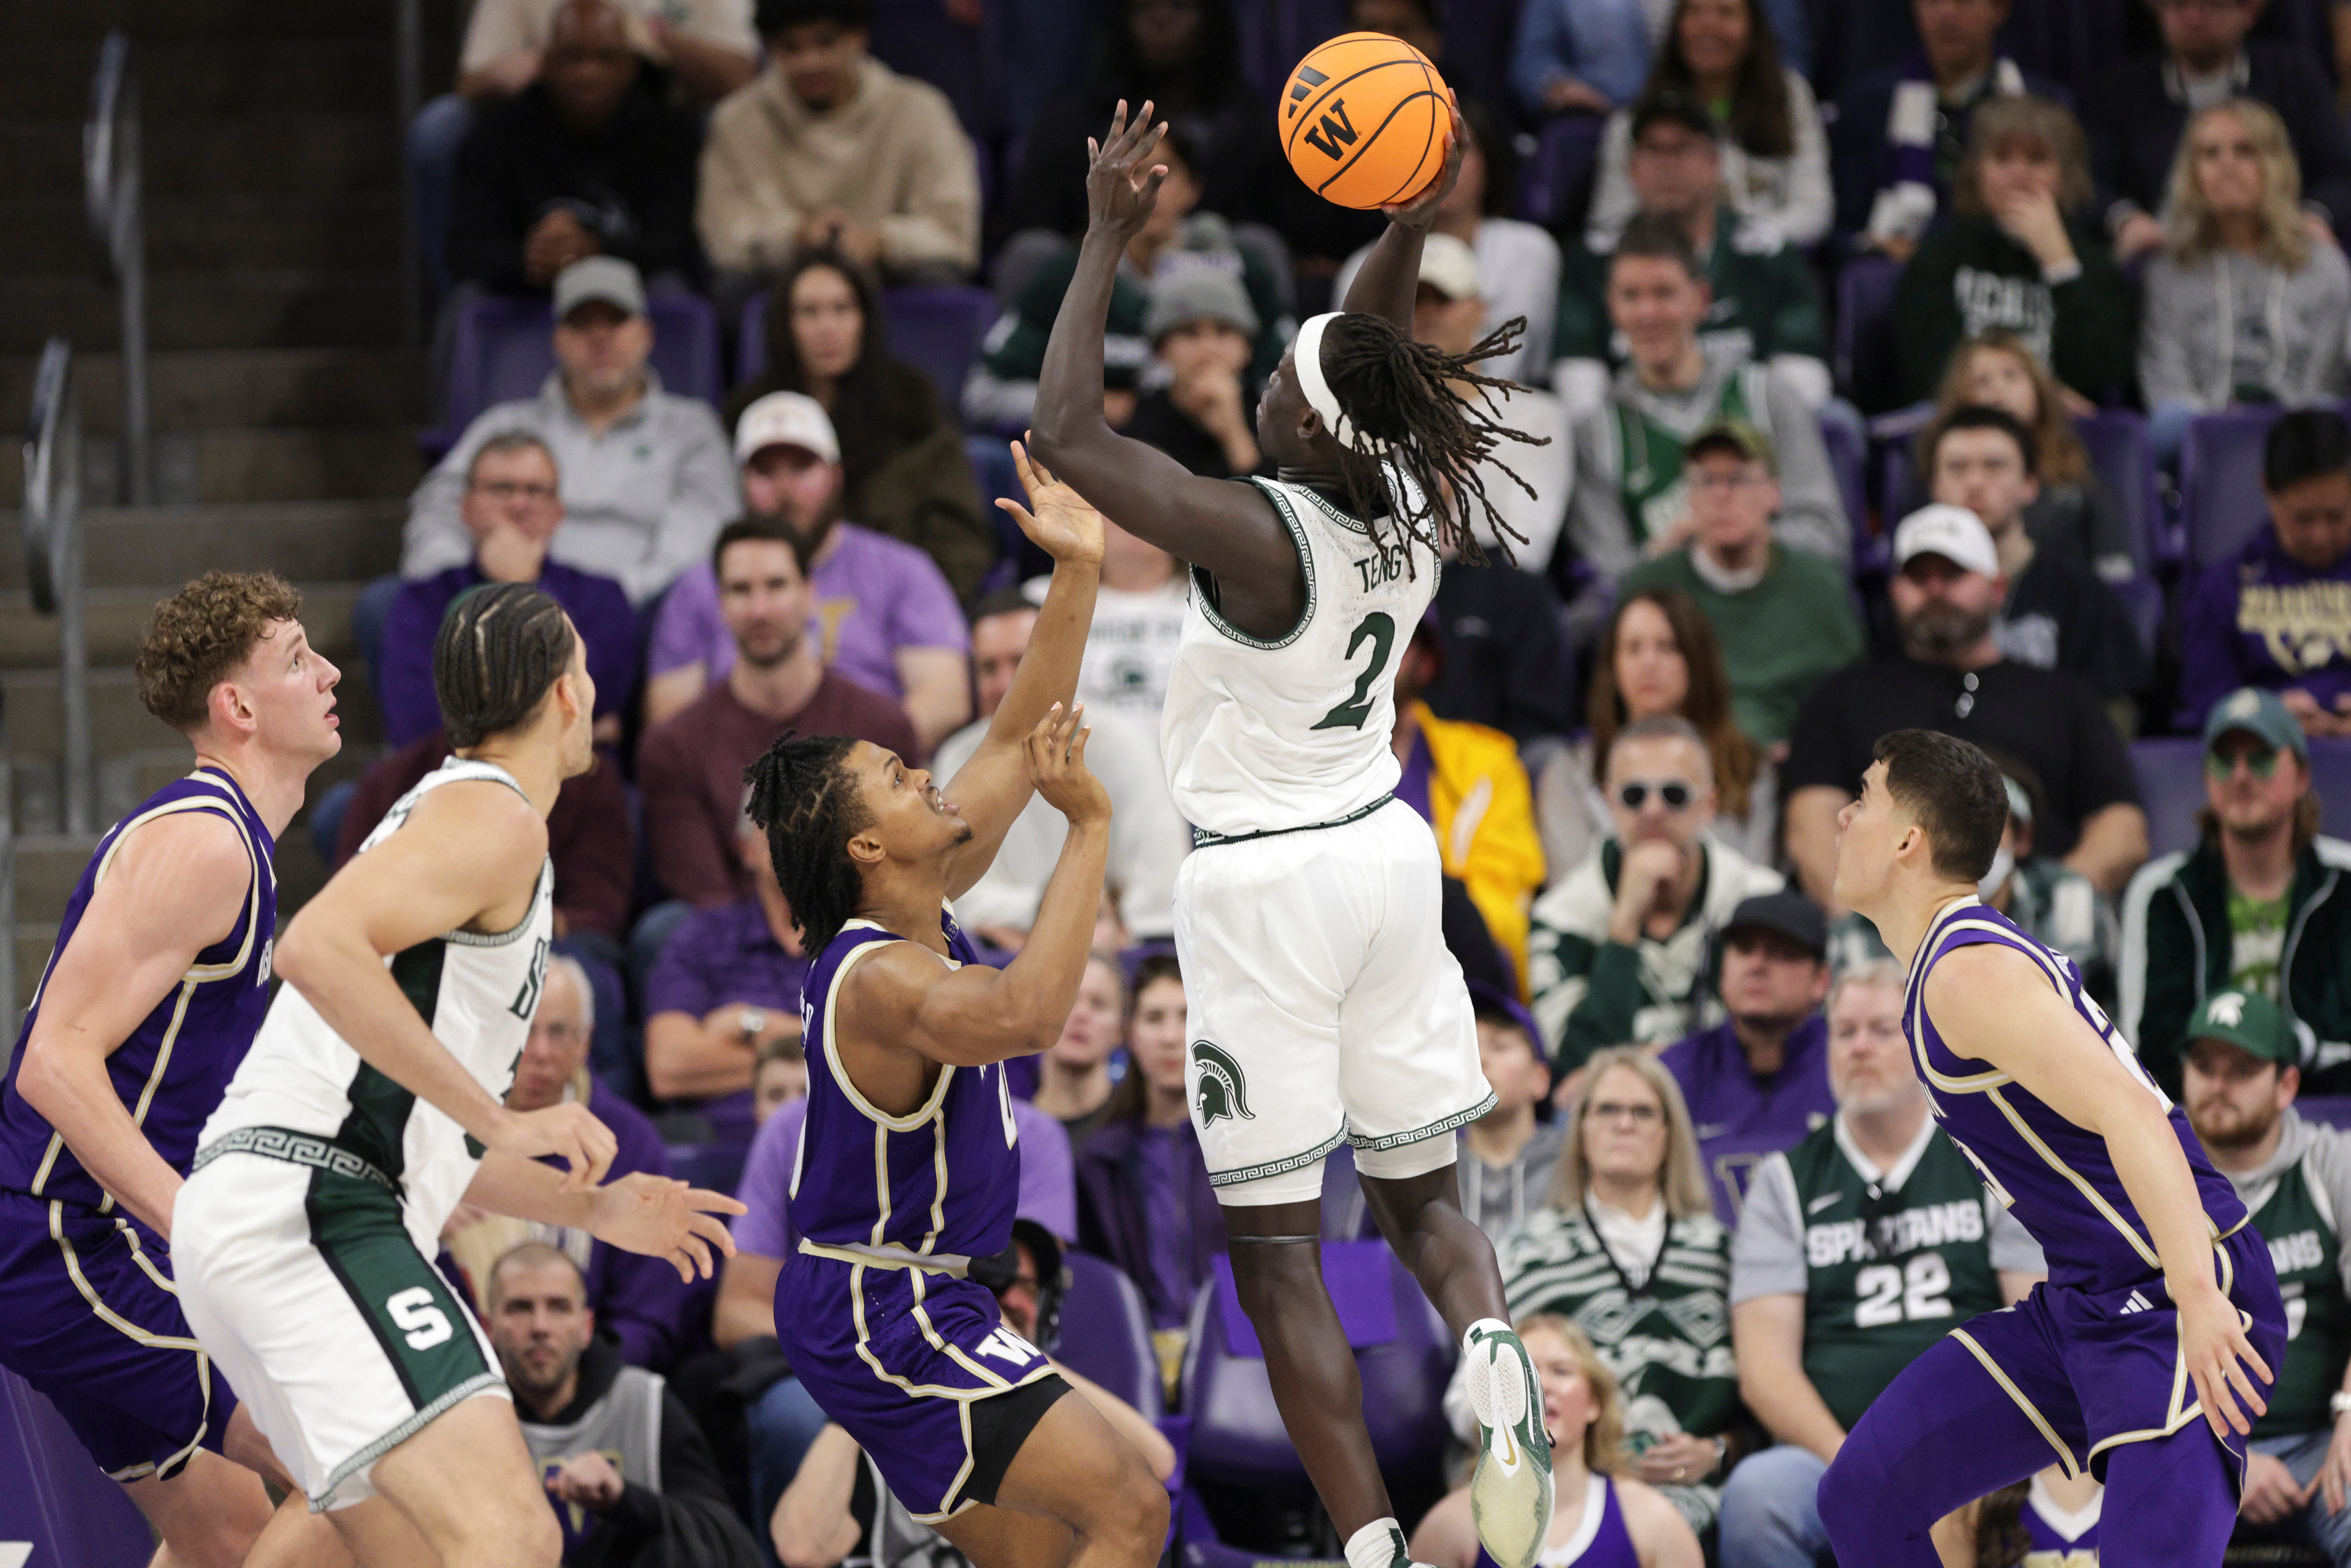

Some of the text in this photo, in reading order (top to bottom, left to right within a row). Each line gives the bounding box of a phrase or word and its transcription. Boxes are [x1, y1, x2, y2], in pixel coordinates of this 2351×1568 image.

[1303, 97, 1358, 161] W
[1354, 544, 1403, 593] TENG
[1309, 611, 1395, 731] 2
[385, 1285, 454, 1351] S
[1854, 1251, 1953, 1329] 22
[974, 1325, 1042, 1367] W
